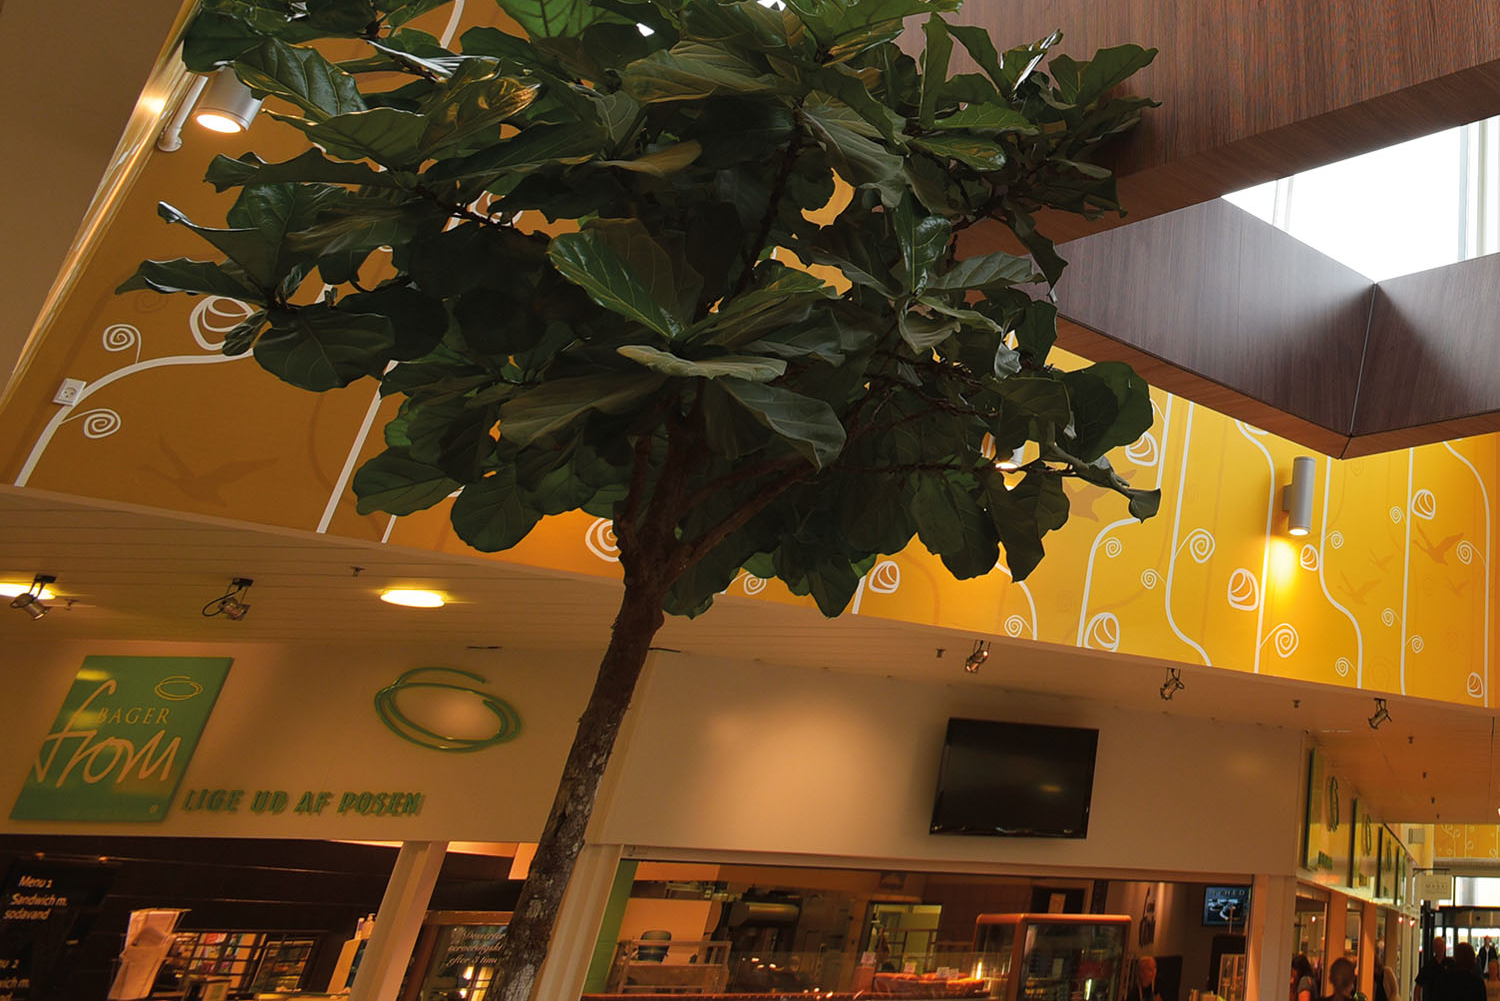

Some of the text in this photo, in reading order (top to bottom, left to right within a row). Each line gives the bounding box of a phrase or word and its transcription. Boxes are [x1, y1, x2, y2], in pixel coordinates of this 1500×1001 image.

[97, 707, 171, 725] BAGER
[181, 788, 425, 816] LIGE UD AF POSEN
[18, 876, 46, 888] Menu
[10, 893, 55, 906] Sandwich
[4, 908, 52, 920] sodavand
